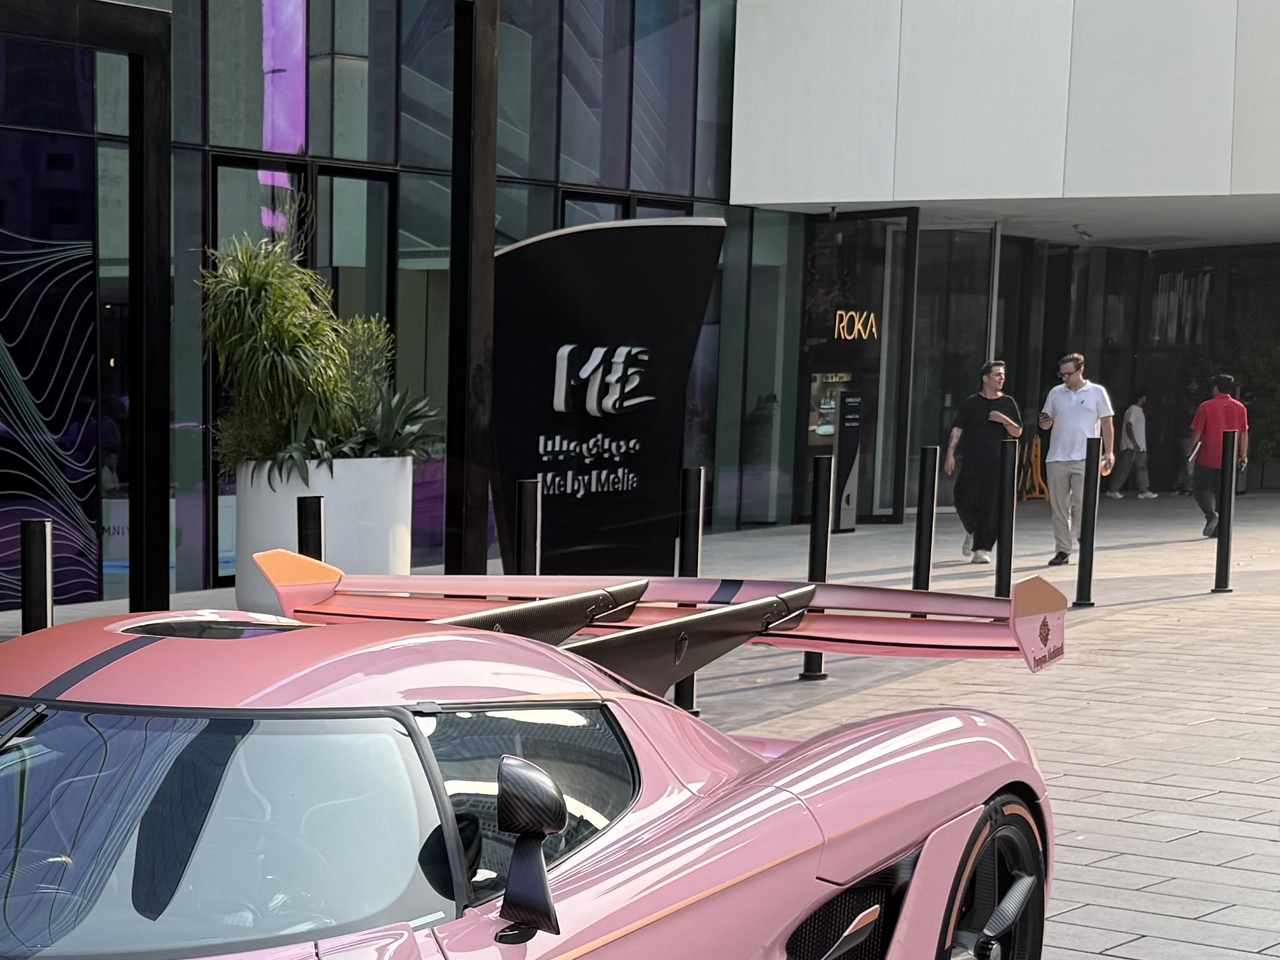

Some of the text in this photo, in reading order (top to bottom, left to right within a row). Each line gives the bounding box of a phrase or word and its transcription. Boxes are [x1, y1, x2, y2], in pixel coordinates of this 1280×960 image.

[834, 310, 878, 340] ROKA
[553, 344, 656, 417] ME
[538, 472, 565, 495] Me
[566, 469, 589, 498] by
